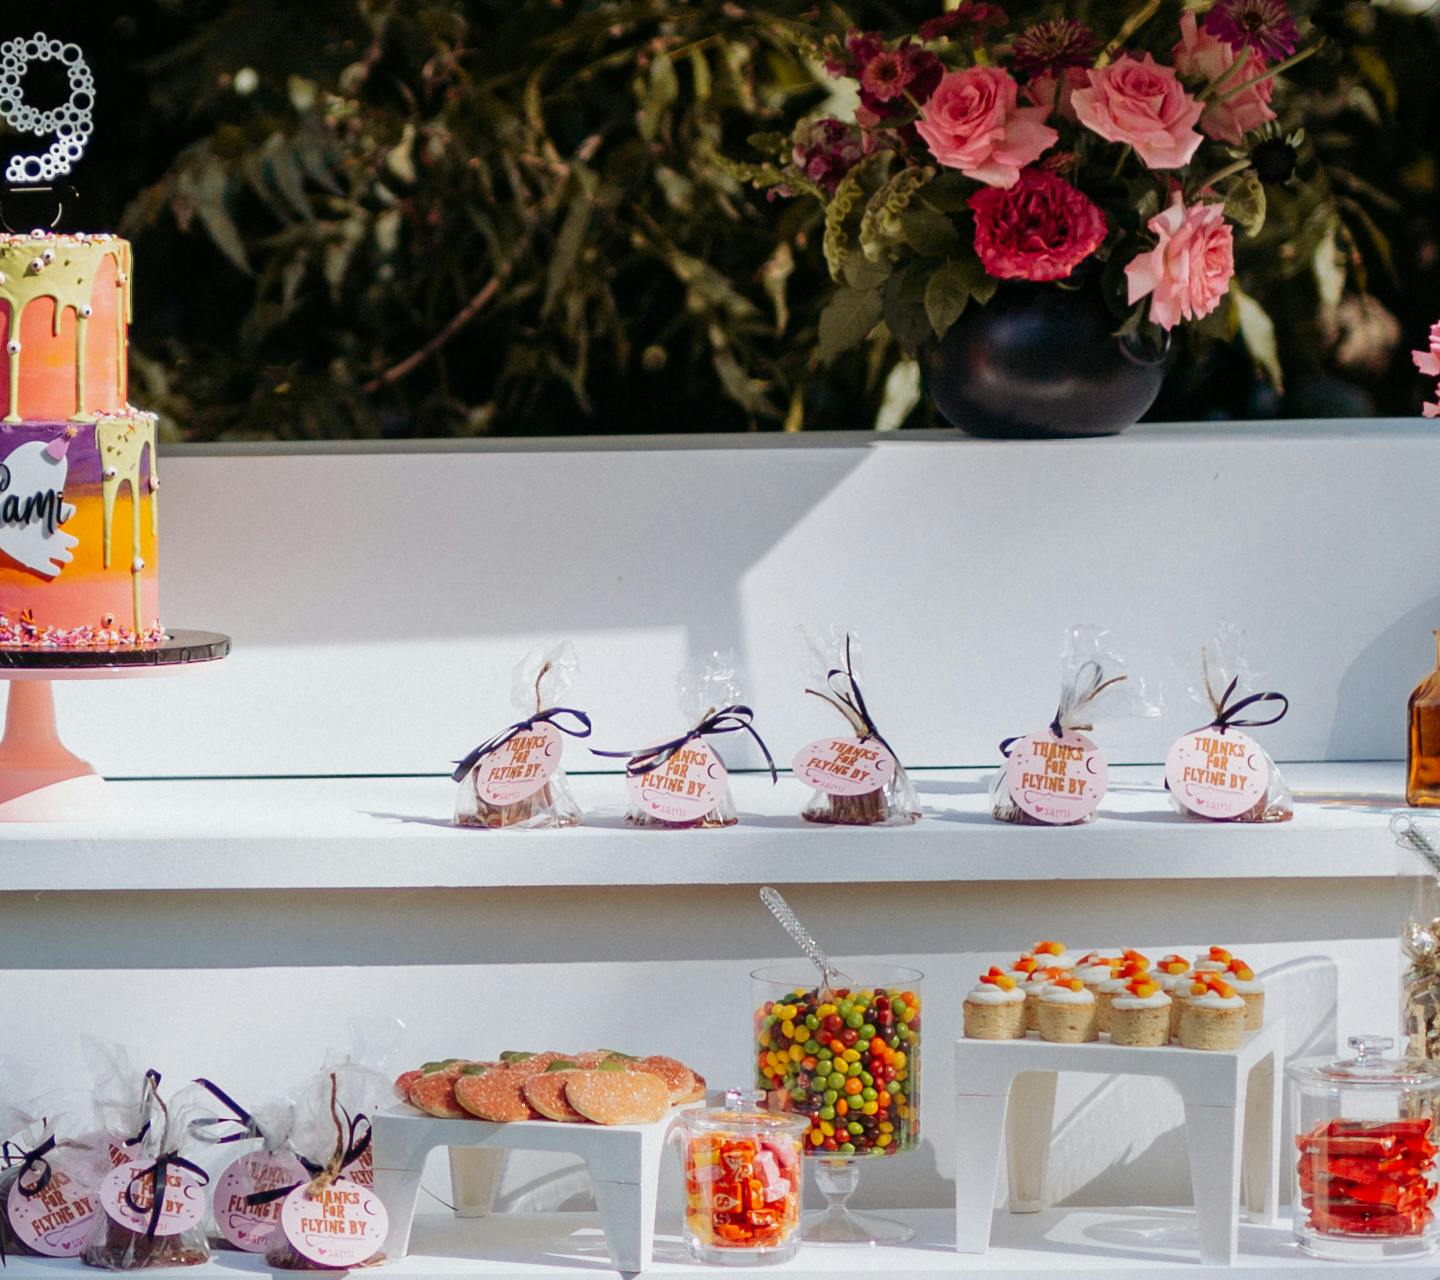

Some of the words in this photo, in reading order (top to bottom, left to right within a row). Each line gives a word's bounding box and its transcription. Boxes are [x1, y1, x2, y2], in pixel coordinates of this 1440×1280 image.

[506, 735, 547, 752] THANKS
[829, 741, 879, 761] THANKS
[1032, 741, 1084, 761] THANKS
[1194, 737, 1246, 758] THANKS
[510, 750, 531, 766] FOR
[671, 748, 707, 767] ANKS
[833, 753, 859, 767] FOR
[1044, 758, 1067, 776] FOR
[1206, 754, 1229, 771] FOR
[487, 764, 524, 782] FLYING
[524, 763, 542, 778] BY
[666, 761, 689, 778] FOR
[806, 757, 850, 775] FLYING
[849, 768, 871, 782] BY
[1183, 766, 1226, 786] FLYING
[1230, 773, 1248, 791] BY
[641, 772, 685, 792] FLYING
[687, 780, 706, 797] BY
[1021, 772, 1065, 793] FLYING
[1068, 777, 1087, 795] BY
[41, 1190, 68, 1212] FOR
[165, 1199, 184, 1215] BY
[312, 1190, 360, 1205] HANKS
[31, 1205, 76, 1237] FLYING
[72, 1196, 94, 1217] BY
[322, 1205, 345, 1218] FOR
[300, 1217, 345, 1234] FLYING
[349, 1221, 368, 1236] BY
